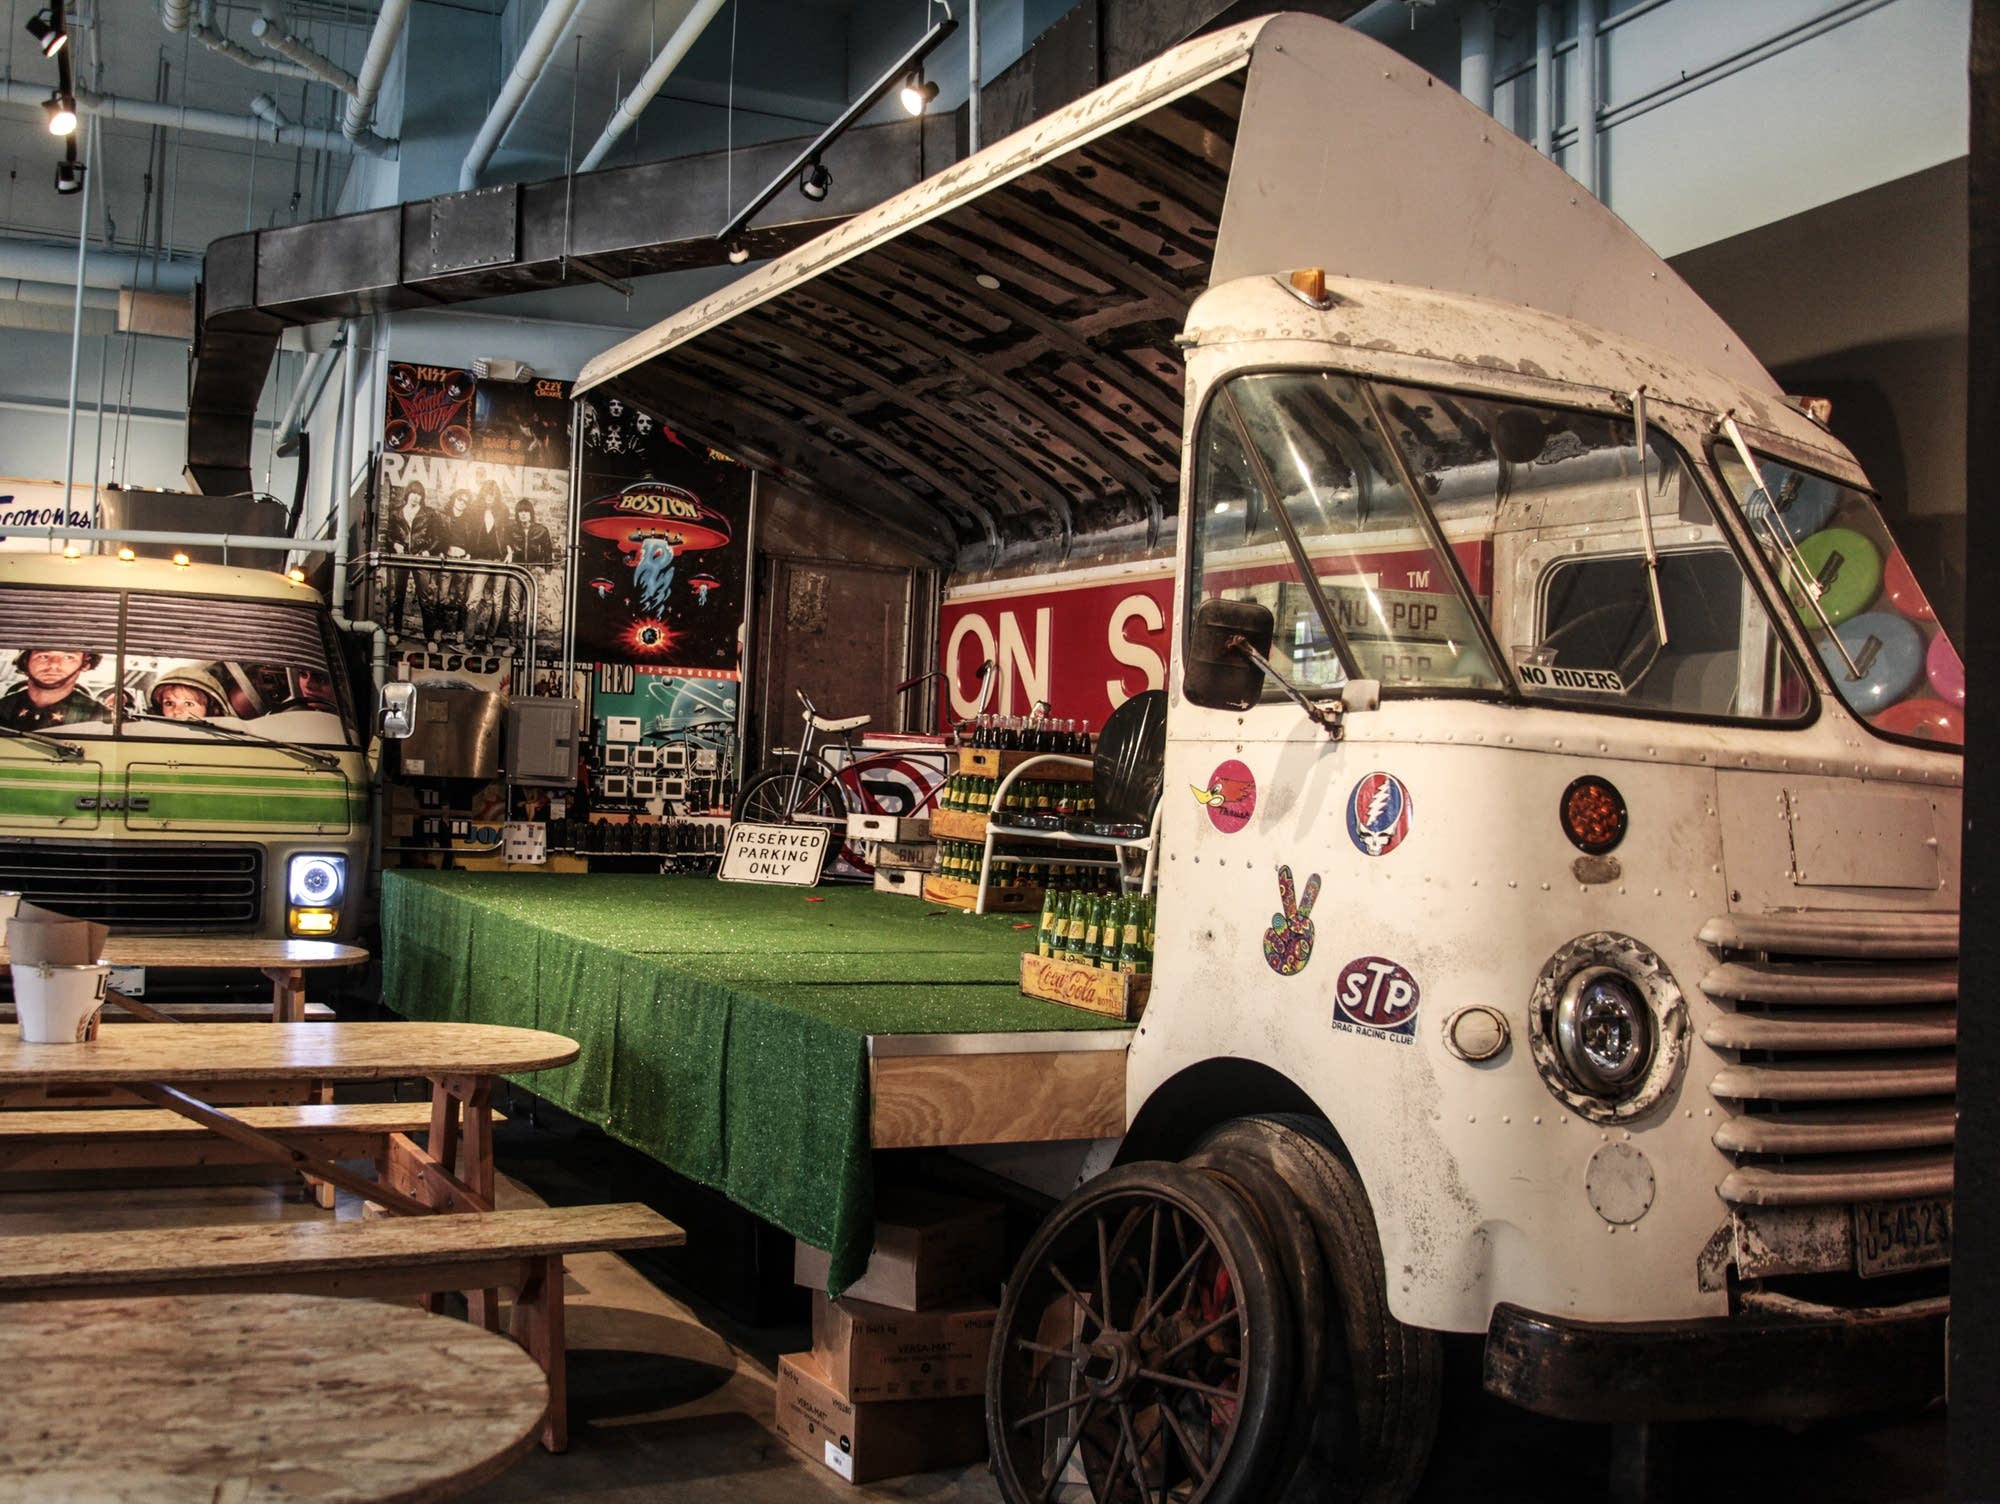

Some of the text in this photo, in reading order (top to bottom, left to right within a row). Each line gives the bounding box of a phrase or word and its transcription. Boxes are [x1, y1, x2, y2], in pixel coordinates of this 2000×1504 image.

[417, 367, 447, 382] KISS
[381, 453, 568, 498] RAMONES
[620, 494, 698, 518] BOSTON
[1406, 571, 1430, 588] TM
[1393, 602, 1438, 630] POP
[601, 663, 635, 694] REO
[1518, 665, 1622, 690] NO RIDERS
[75, 796, 151, 811] GMC
[735, 831, 820, 849] RESERVED
[738, 847, 809, 864] PARKING
[749, 861, 791, 876] ONLY
[1341, 961, 1412, 1018] STP
[1331, 1021, 1414, 1045] DRAG RACING CLUB
